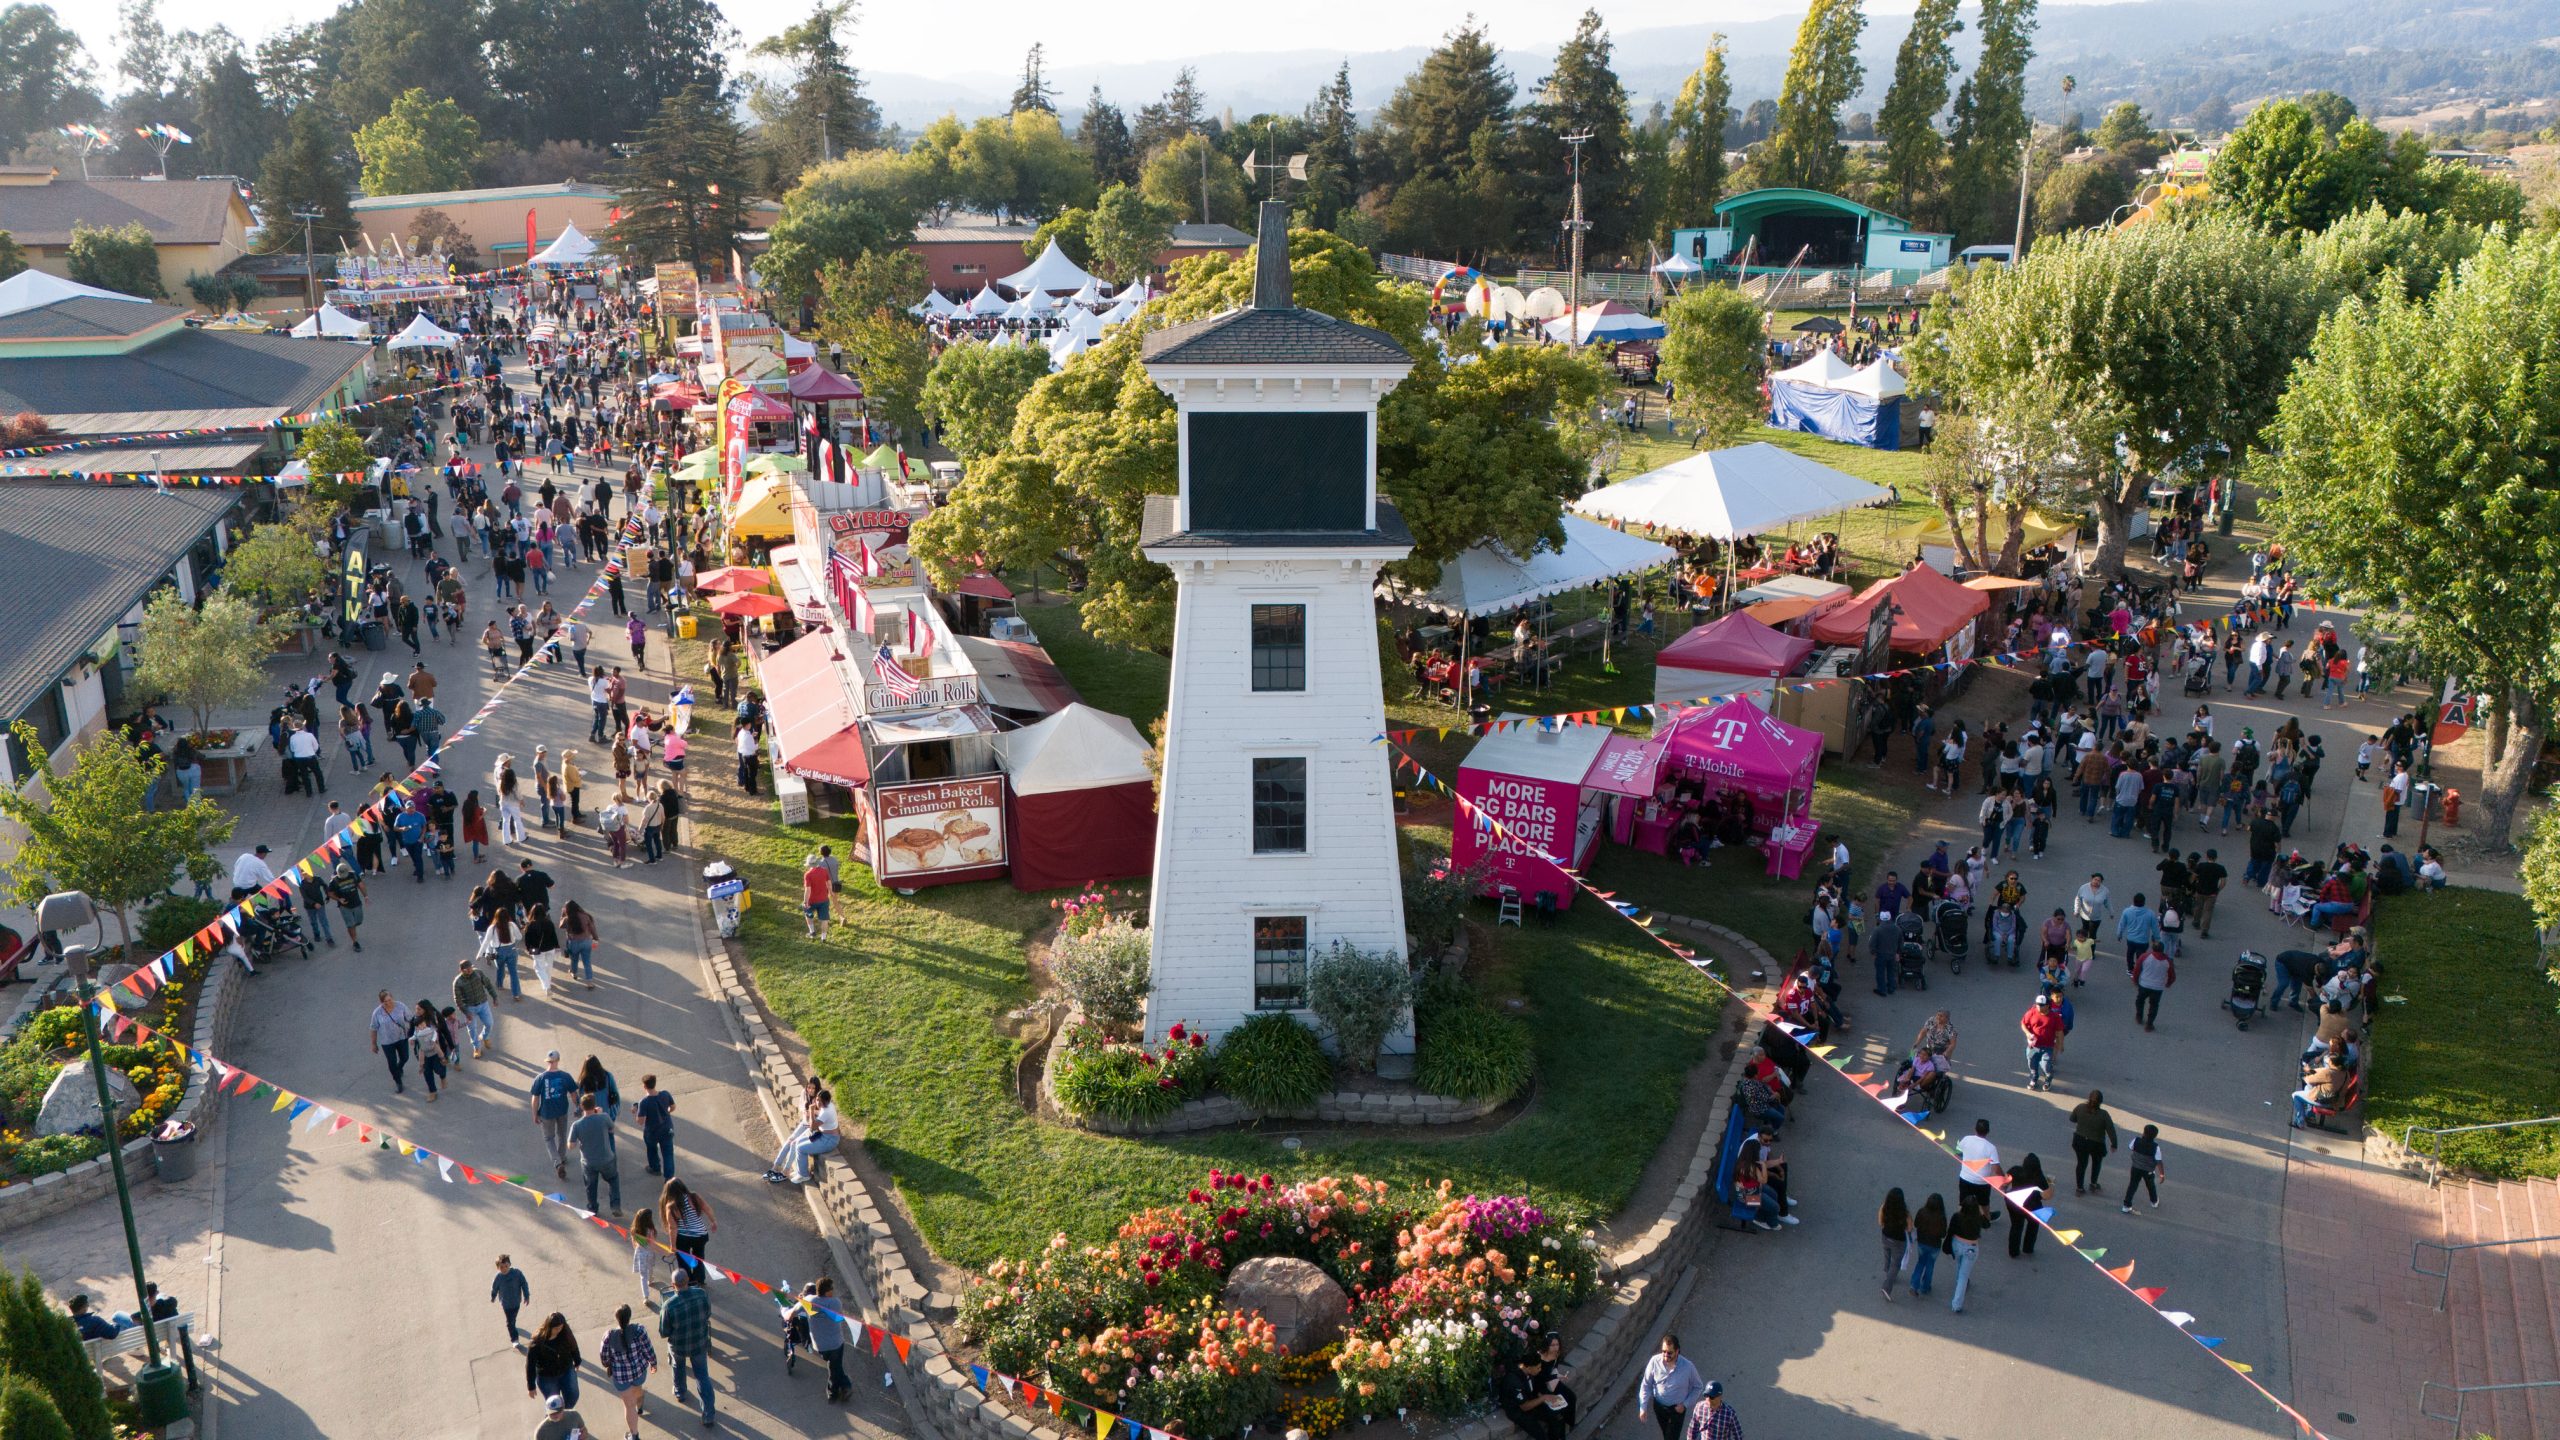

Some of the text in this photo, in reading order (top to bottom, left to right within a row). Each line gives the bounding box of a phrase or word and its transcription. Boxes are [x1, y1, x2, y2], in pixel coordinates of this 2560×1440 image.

[829, 510, 911, 532] GYROS
[345, 550, 364, 621] ATM
[943, 681, 976, 702] Rolls
[795, 766, 812, 777] Gold
[812, 770, 832, 782] Medal
[1699, 756, 1745, 778] Mobile
[898, 785, 982, 804] Fresh Baked
[1488, 779, 1546, 803] MORE
[887, 796, 994, 817] Cinnamon Rolls
[1475, 795, 1557, 824] 5G BARS
[1498, 817, 1555, 842] MORE
[1475, 832, 1550, 859] PLACES
